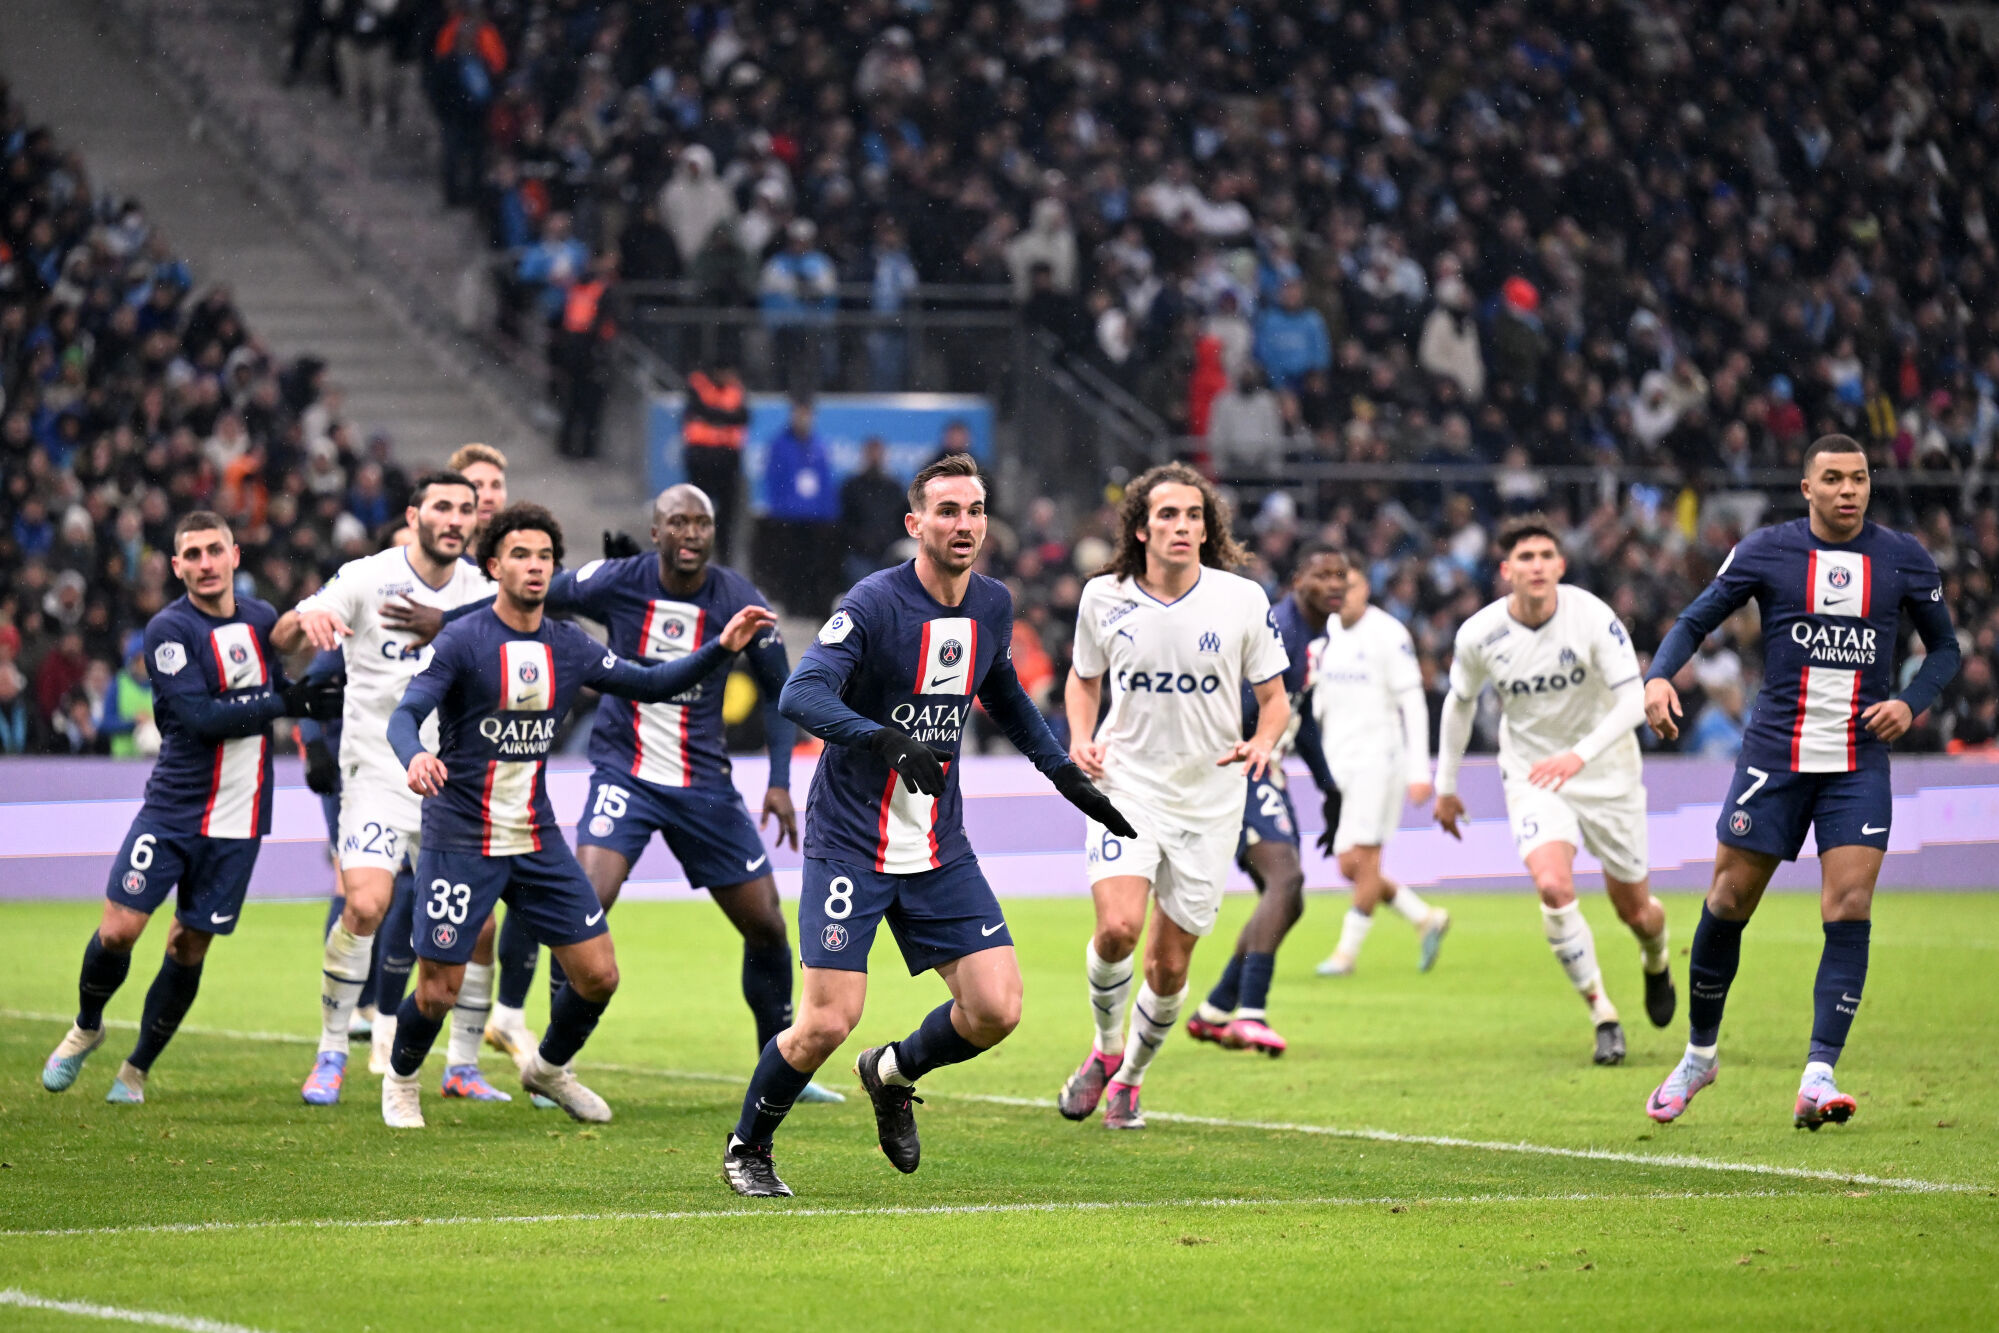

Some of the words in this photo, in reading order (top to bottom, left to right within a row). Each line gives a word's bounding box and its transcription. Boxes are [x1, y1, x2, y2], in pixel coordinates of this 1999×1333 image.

[1791, 621, 1877, 651] QATAR
[1810, 646, 1876, 665] AIRWAYS
[479, 717, 555, 744] QATAR
[592, 783, 631, 819] 15
[1736, 766, 1769, 806] 7
[363, 821, 398, 859] 23
[1522, 812, 1538, 840] 5
[130, 833, 157, 871] 6
[1102, 829, 1122, 862] 6
[426, 878, 472, 925] 33
[824, 876, 854, 920] 8
